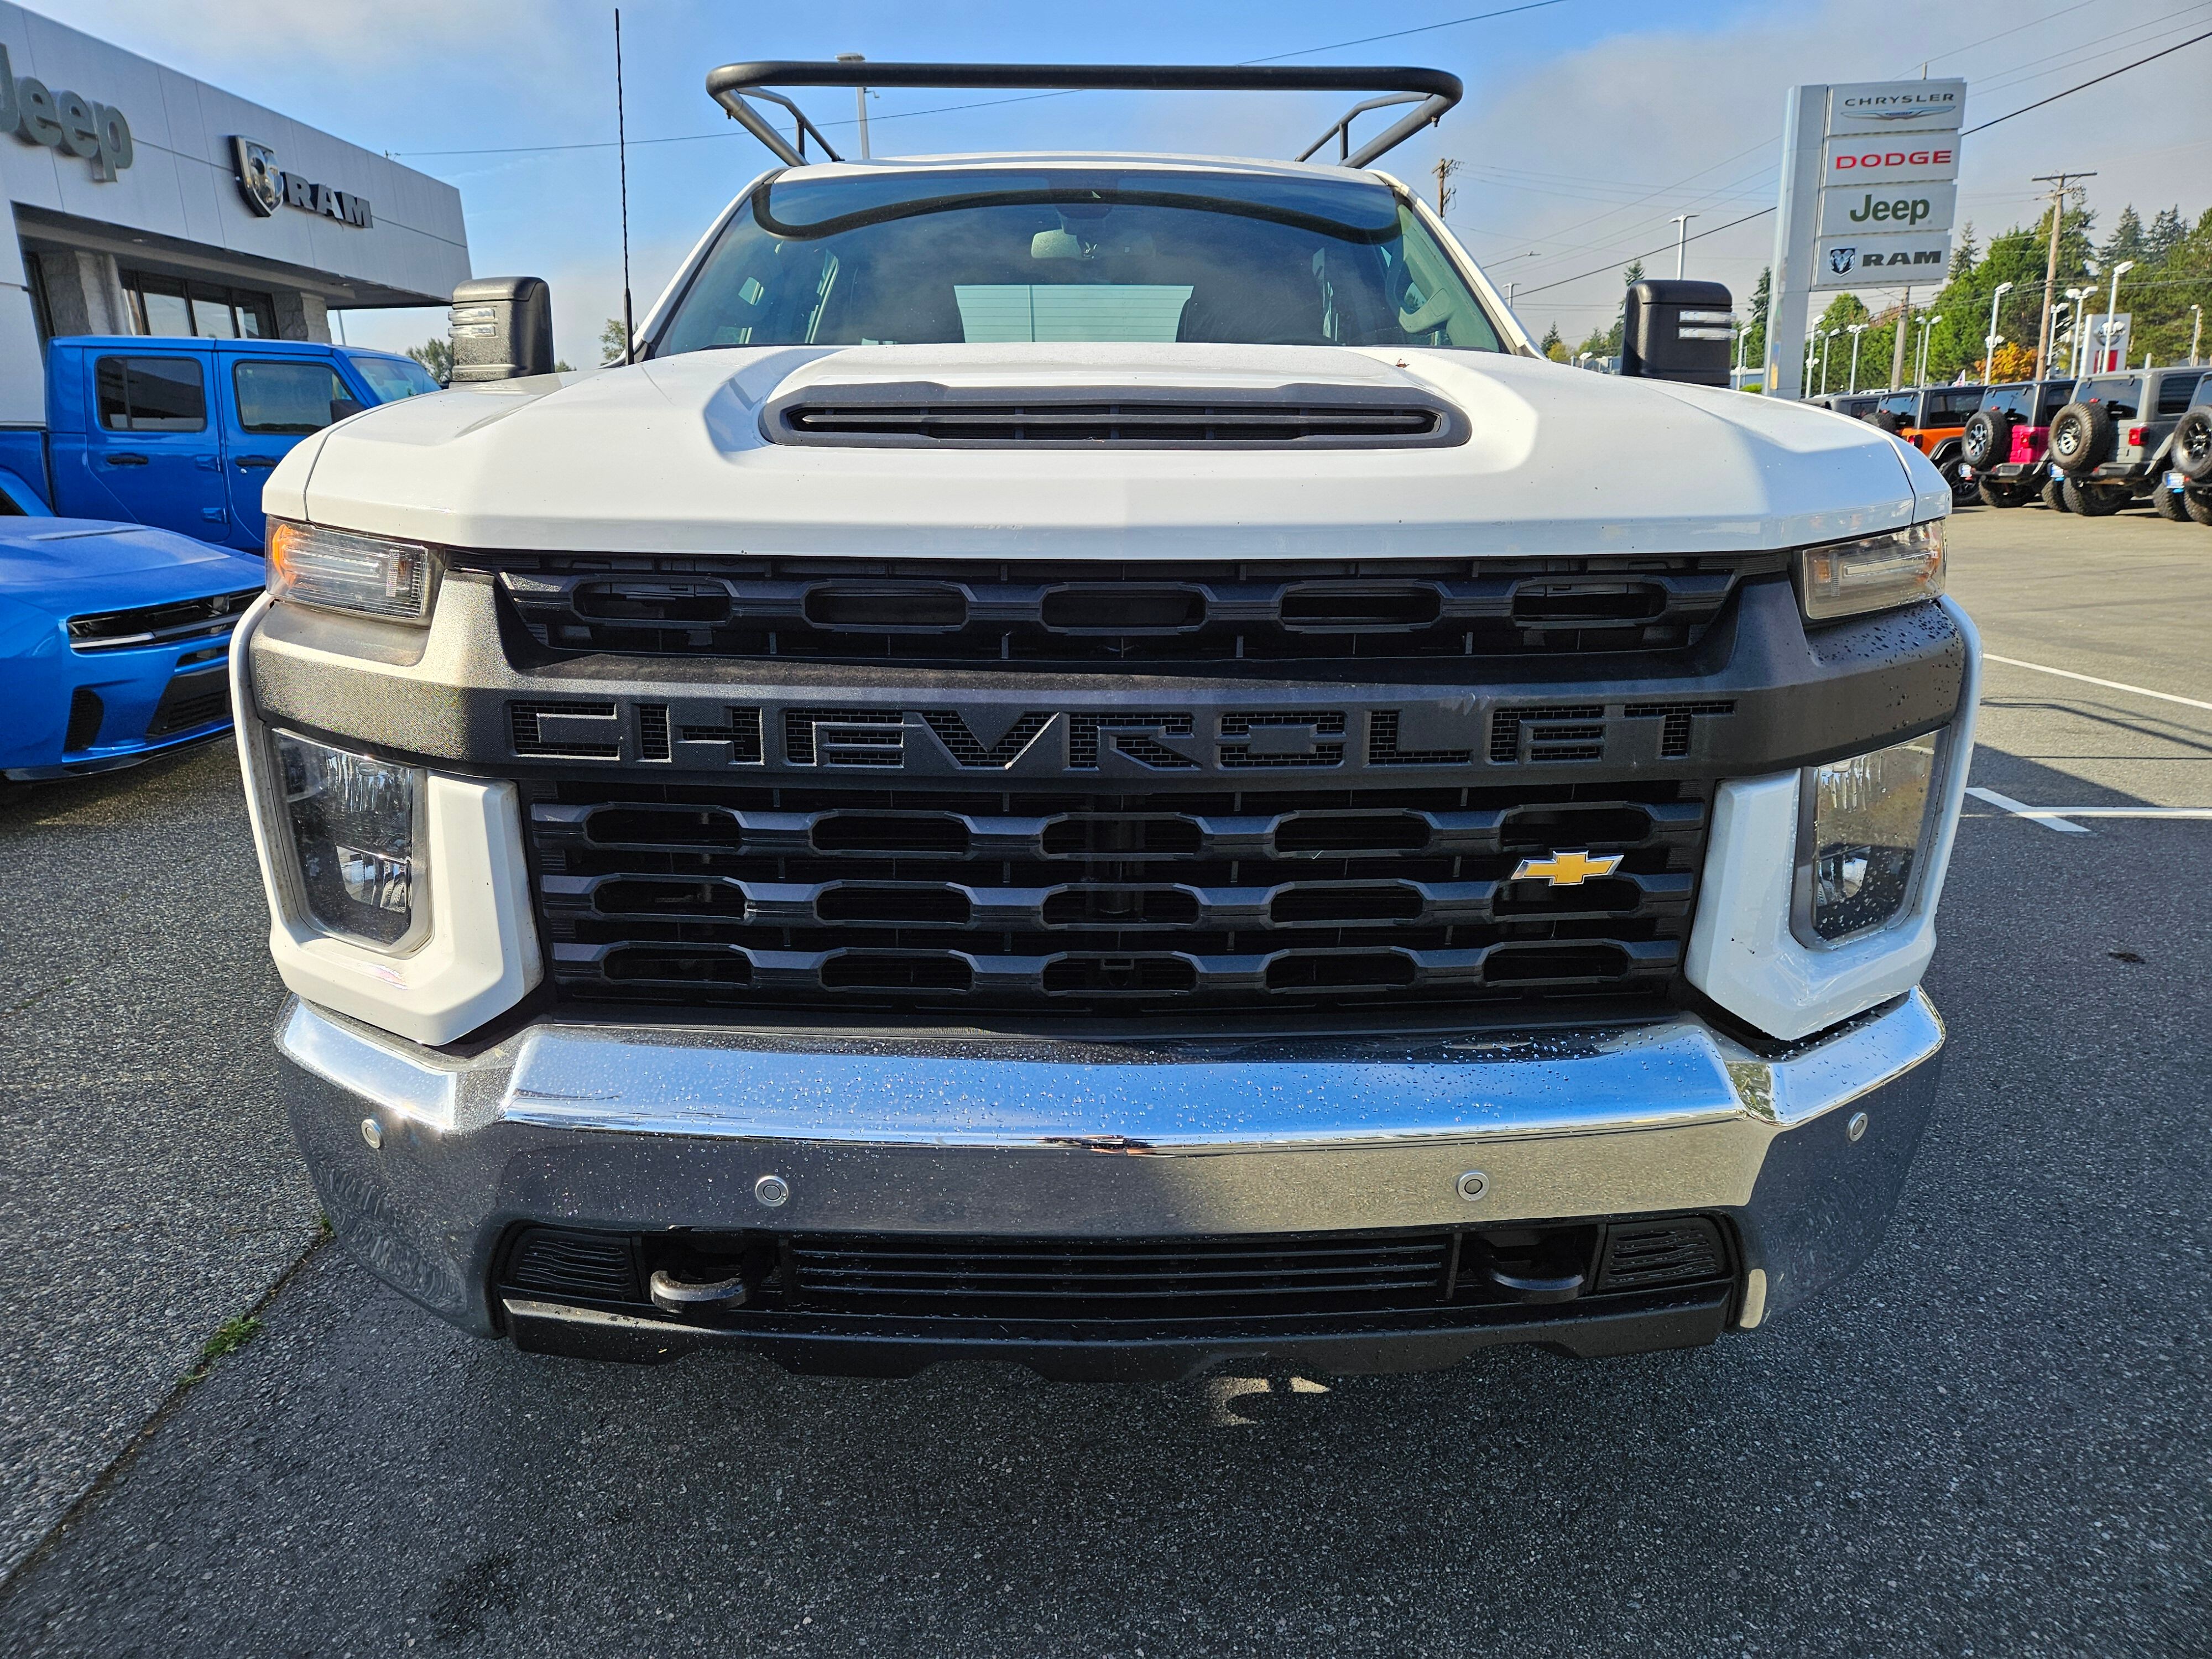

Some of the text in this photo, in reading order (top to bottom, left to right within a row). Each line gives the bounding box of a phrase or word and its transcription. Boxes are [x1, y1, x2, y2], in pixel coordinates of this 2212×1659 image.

[1845, 93, 1954, 107] CHRYSLER
[1835, 150, 1952, 170] DODGE
[280, 171, 373, 228] RAM
[1850, 194, 1930, 225] Jeep
[1862, 251, 1942, 267] RAM
[504, 699, 1738, 771] CHEVROLET
